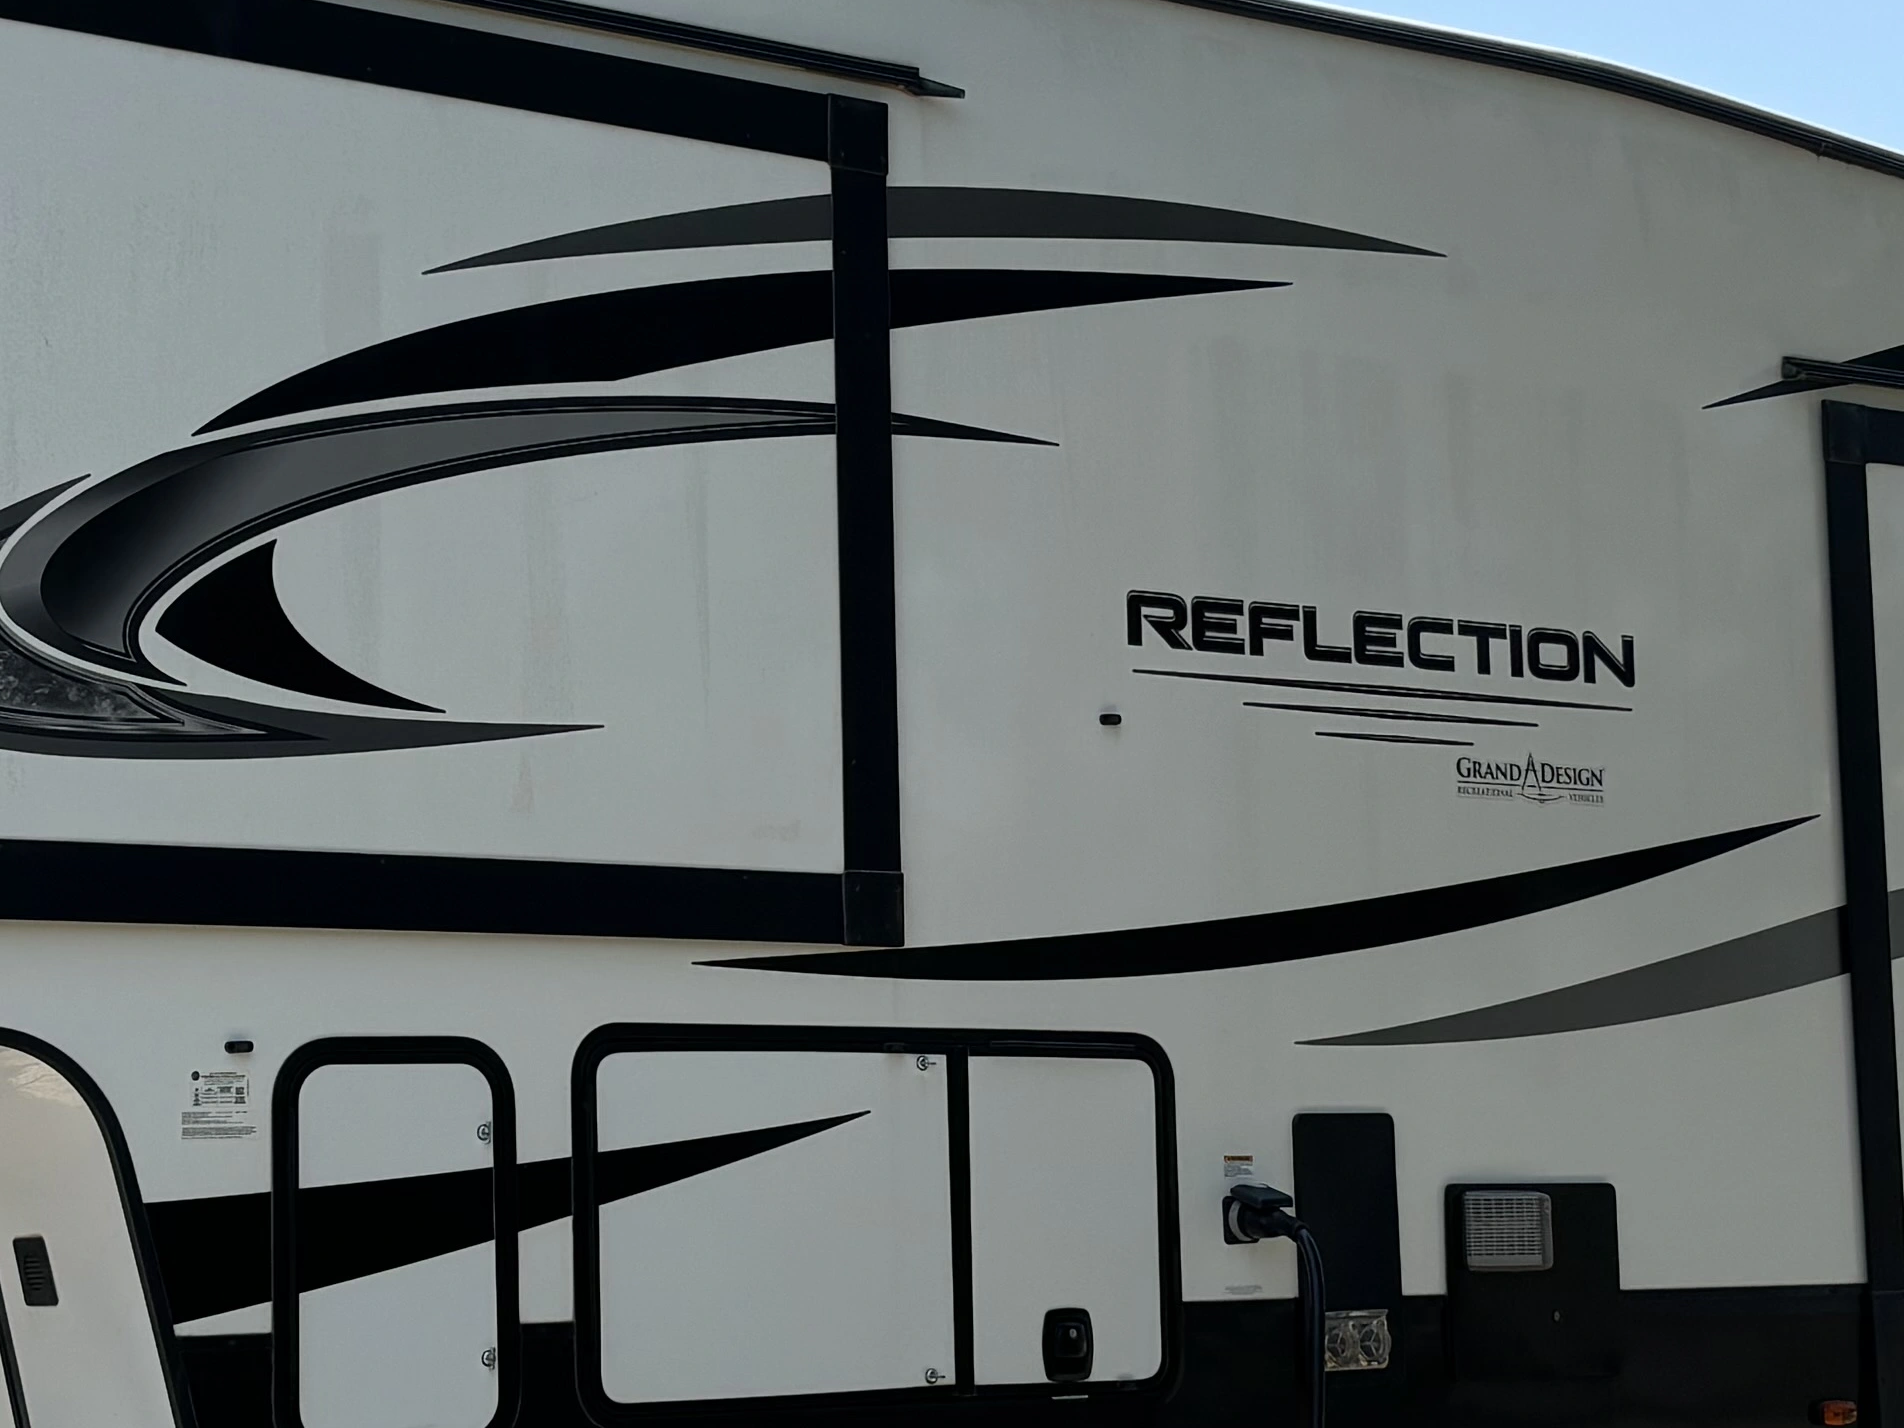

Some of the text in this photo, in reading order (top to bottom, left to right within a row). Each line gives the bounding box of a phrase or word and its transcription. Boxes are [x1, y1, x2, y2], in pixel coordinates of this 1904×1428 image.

[1126, 589, 1636, 688] REFLECTION
[1456, 756, 1605, 787] GRAND DESIGN
